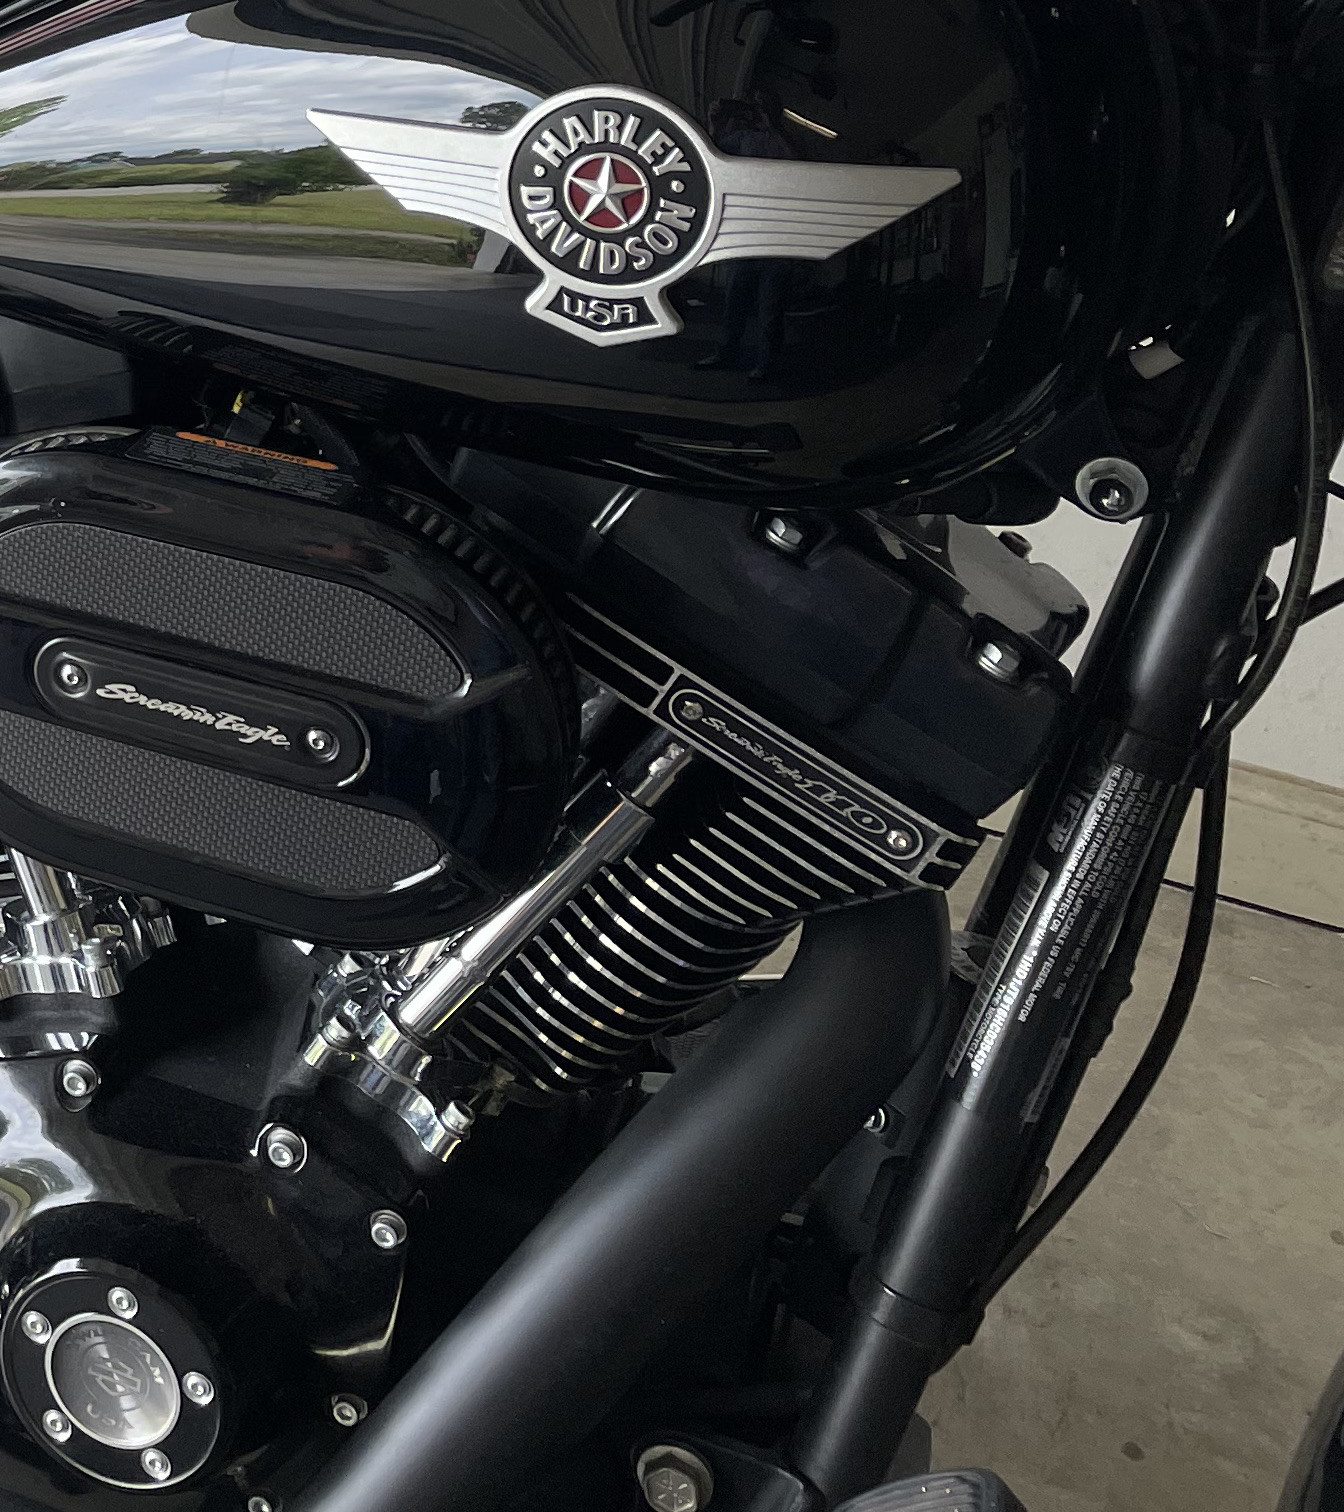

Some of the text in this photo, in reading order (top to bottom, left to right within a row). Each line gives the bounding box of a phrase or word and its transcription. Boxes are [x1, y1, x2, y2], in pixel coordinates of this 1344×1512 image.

[519, 108, 697, 275] HARLEY DAVIDSON
[562, 293, 639, 326] USA
[1097, 800, 1119, 832] SAFETY
[1113, 788, 1136, 824] VEHICLE
[1065, 811, 1101, 872] MANUFACTURE
[1074, 831, 1104, 880] STANDARDS
[1091, 823, 1119, 870] CONFORMS
[1054, 896, 1085, 946] APPLICABLE
[1055, 887, 1077, 920] EFFECT
[1031, 956, 1056, 994] FEDERAL
[1017, 992, 1038, 1023] MOTOR
[964, 1006, 995, 1058] MOTORCYCLE
